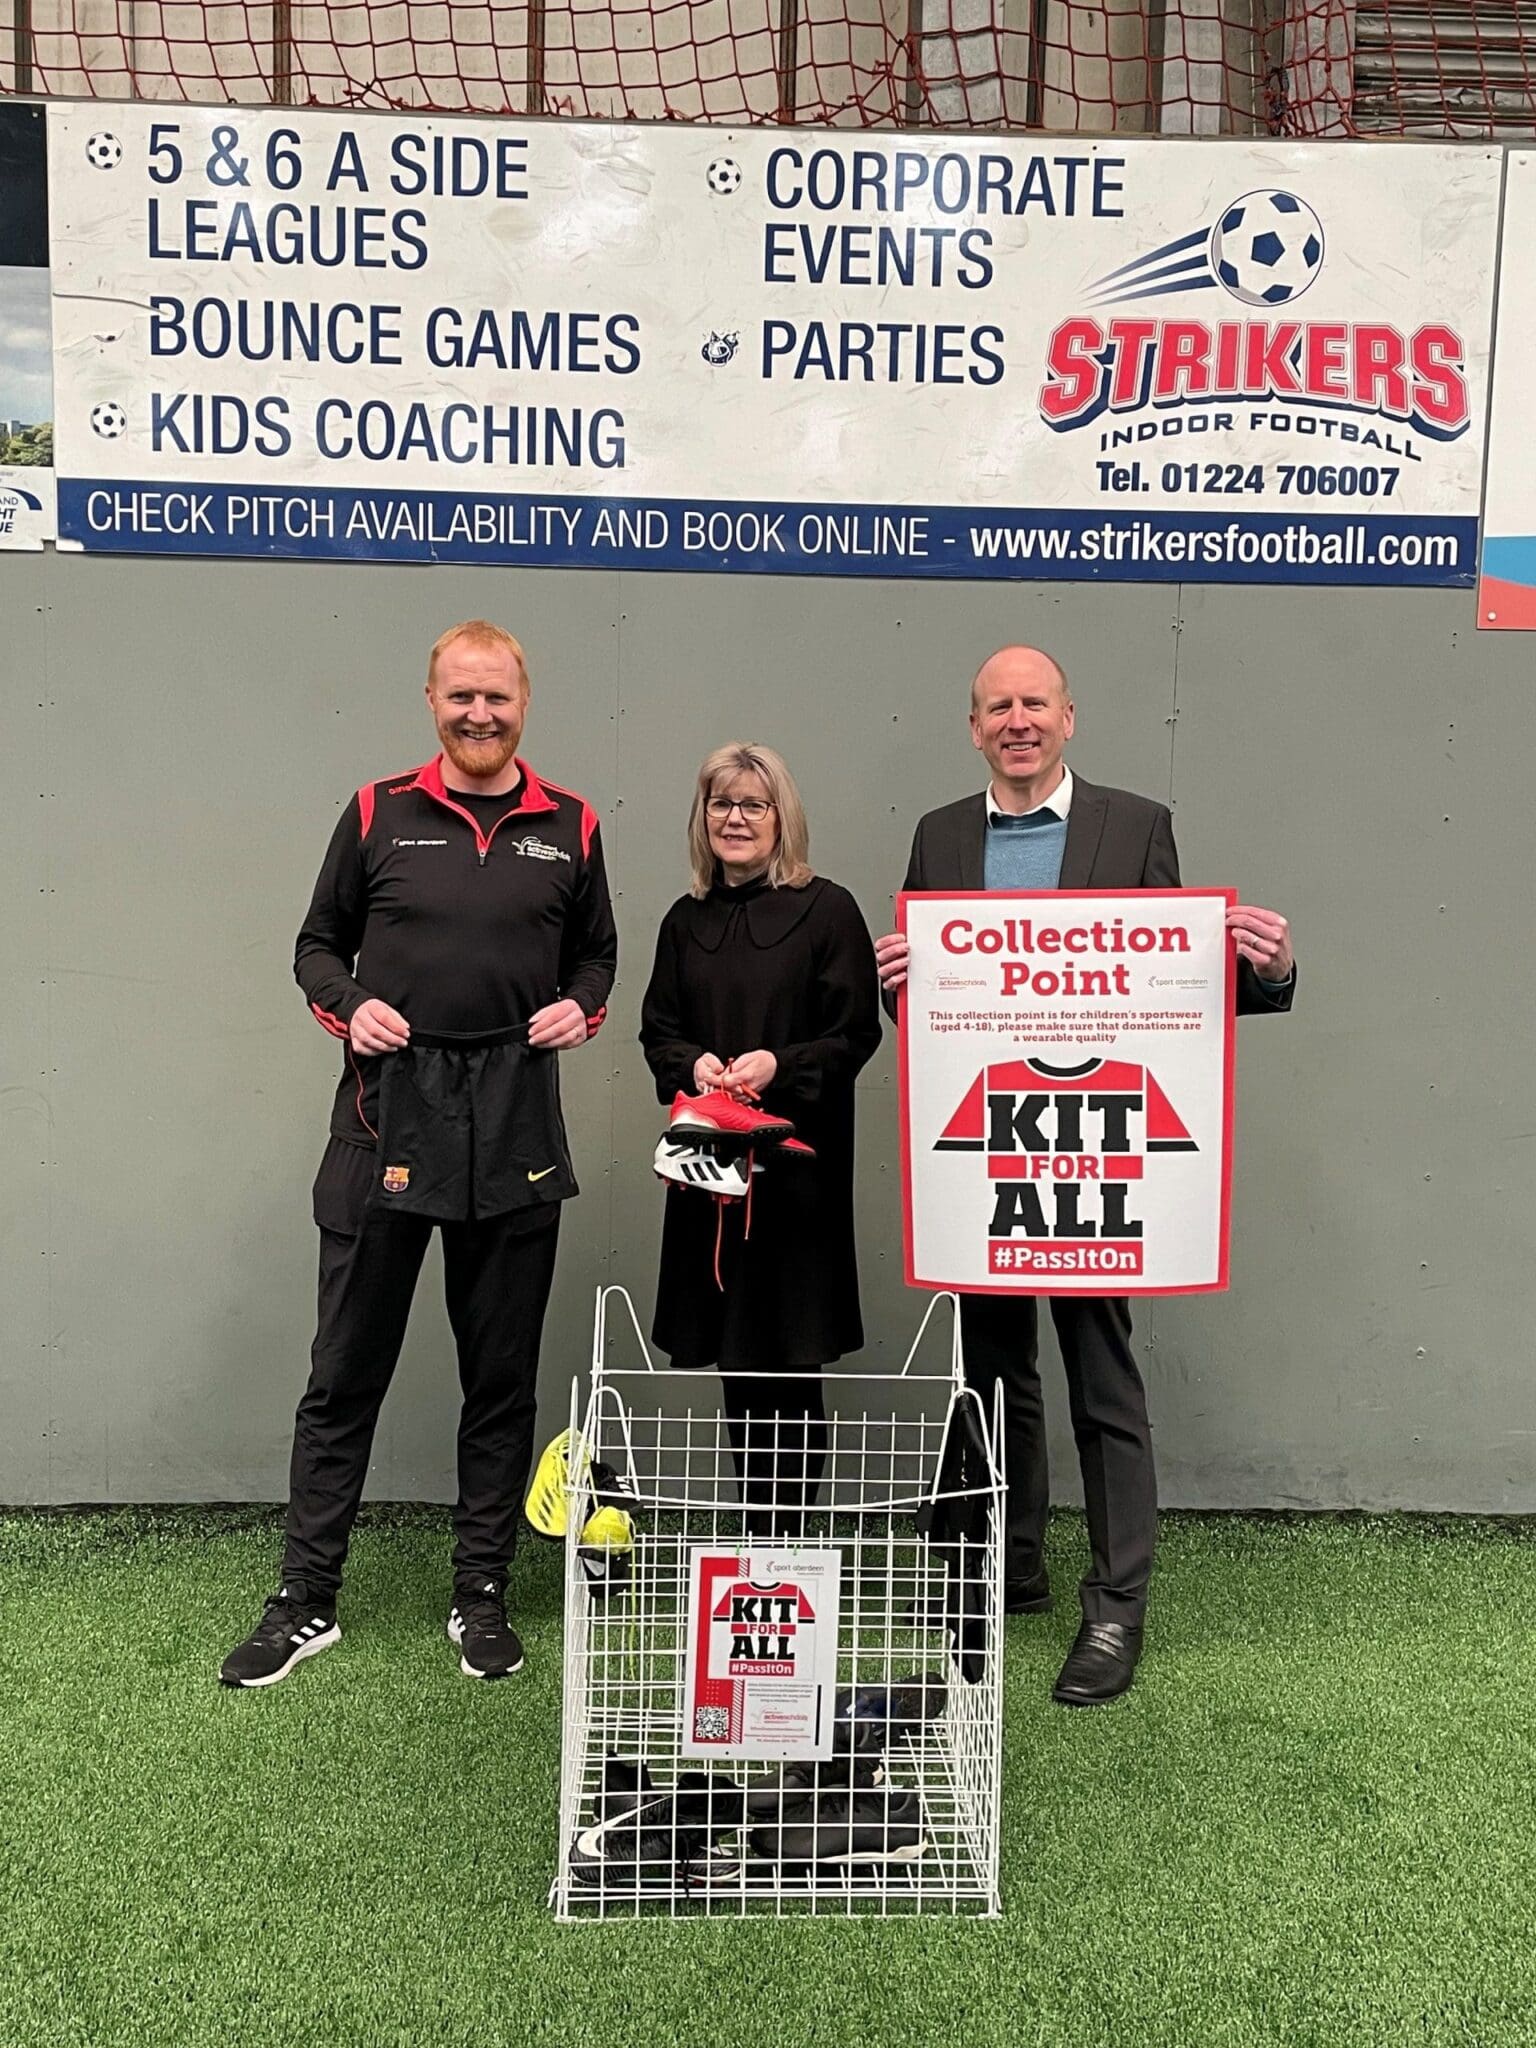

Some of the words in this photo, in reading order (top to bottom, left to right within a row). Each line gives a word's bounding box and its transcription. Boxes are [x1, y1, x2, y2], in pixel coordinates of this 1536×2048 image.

[148, 124, 182, 184] 5
[206, 126, 251, 187] &
[266, 128, 301, 190] 6
[326, 132, 369, 192] A
[391, 134, 528, 199] SIDE
[766, 148, 1125, 218] CORPORATE
[149, 198, 427, 270] LEAGUES
[765, 223, 993, 289] EVENTS
[150, 296, 402, 365] BOUNCE
[426, 307, 640, 374] GAMES
[762, 320, 1004, 386] PARTIES
[1039, 316, 1472, 442] STRIKERS
[151, 393, 291, 457] KIDS
[316, 399, 625, 468] COACHING
[1101, 414, 1234, 451] INDOOR
[1251, 413, 1422, 462] FOOTBALL
[1096, 462, 1150, 492] Tel.
[1162, 463, 1265, 494] 01224
[1277, 466, 1399, 497] 706007
[87, 491, 214, 534] CHECK
[227, 496, 334, 538] PITCH
[346, 501, 582, 546] AVAILABILITY
[591, 509, 668, 549] AND
[683, 512, 786, 553] BOOK
[799, 515, 929, 556] ONLINE
[970, 522, 1458, 567] www.strikersfootball.com
[941, 919, 1190, 954] Collection
[1000, 962, 1130, 996] Point
[929, 1011, 953, 1020] This
[956, 1011, 1011, 1020] collection
[1015, 1011, 1045, 1021] point
[1048, 1011, 1057, 1020] is
[1061, 1011, 1077, 1020] for
[1079, 1010, 1137, 1020] children's
[1139, 1011, 1203, 1021] sportswear
[930, 1022, 961, 1033] (aged
[963, 1022, 995, 1032] 4-18),
[998, 1022, 1033, 1033] please
[1036, 1022, 1066, 1031] make
[1069, 1023, 1094, 1031] sure
[1096, 1022, 1120, 1031] that
[1122, 1021, 1181, 1031] donations
[1183, 1022, 1202, 1031] are
[1013, 1034, 1020, 1042] a
[1022, 1033, 1074, 1042] wearable
[1076, 1033, 1117, 1044] quality
[988, 1094, 1143, 1152] KIT
[1031, 1155, 1099, 1179] FOR
[989, 1182, 1143, 1237] ALL
[995, 1248, 1137, 1270] #PassItOn
[731, 1597, 797, 1623] KIT
[749, 1624, 778, 1635] FOR
[730, 1636, 795, 1660] ALL
[732, 1663, 792, 1675] #PassItOn
